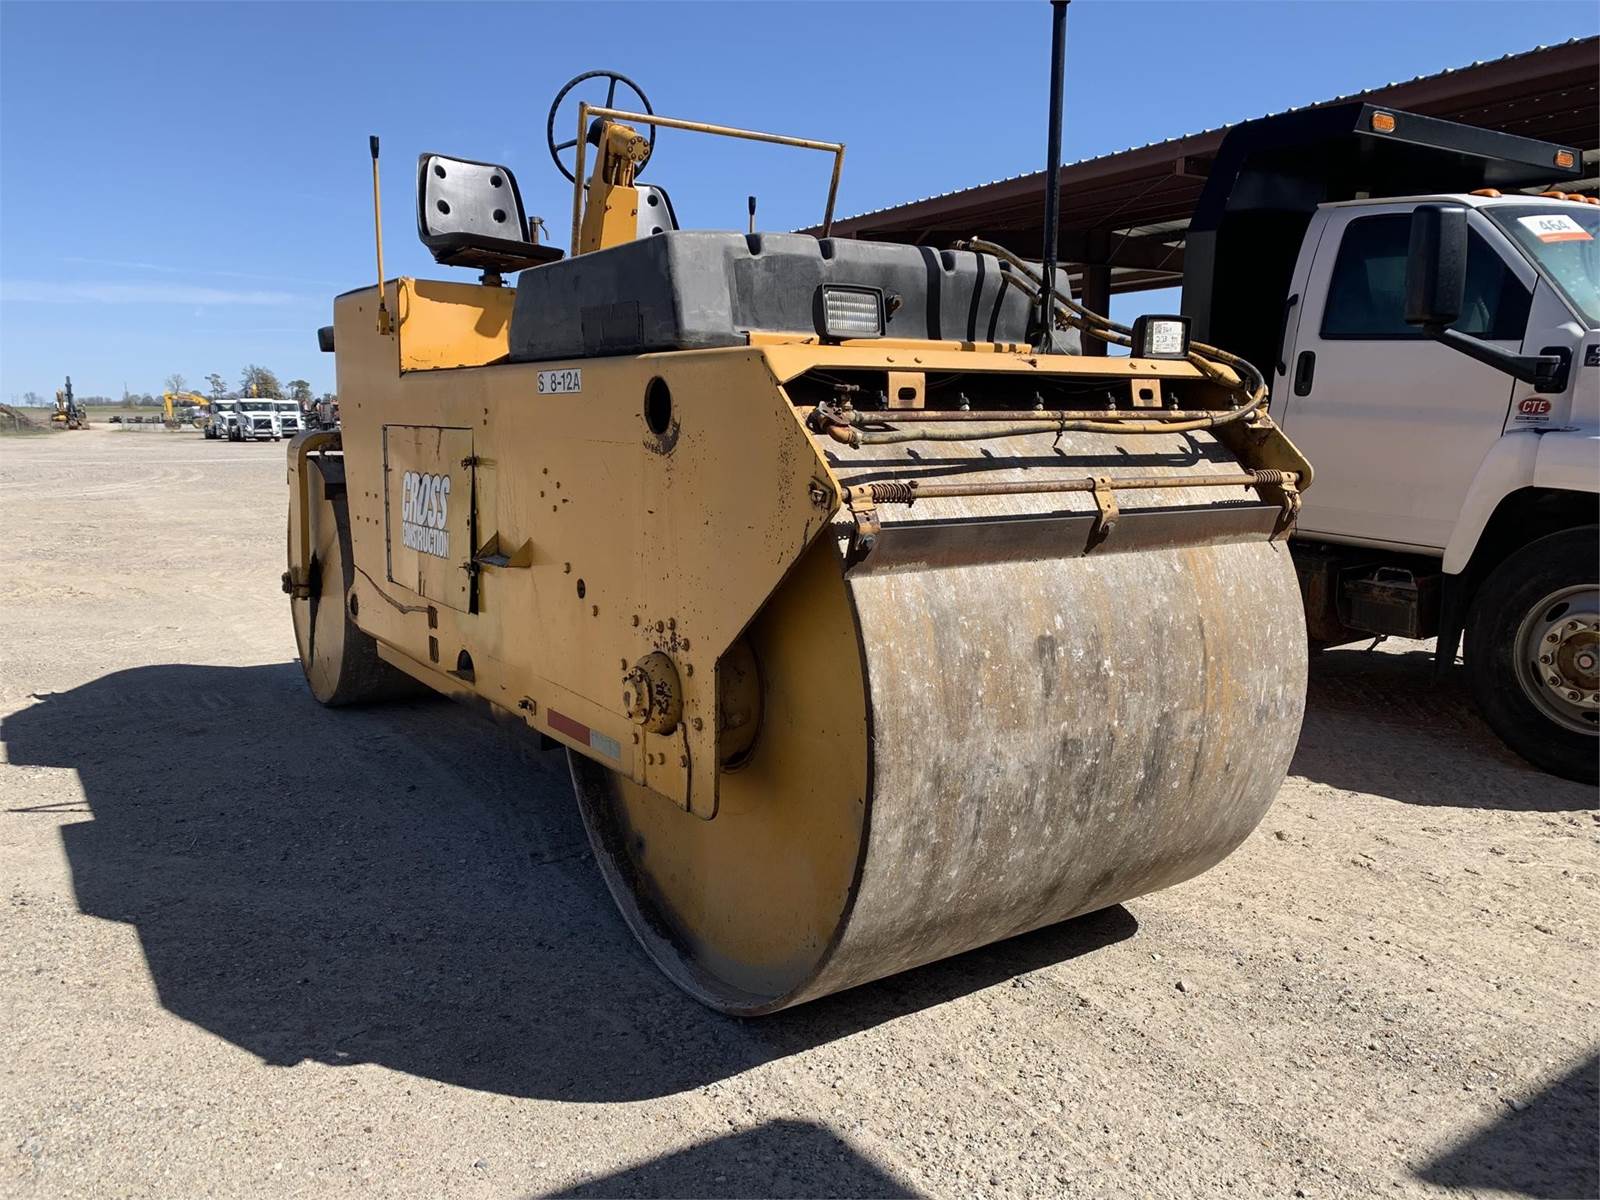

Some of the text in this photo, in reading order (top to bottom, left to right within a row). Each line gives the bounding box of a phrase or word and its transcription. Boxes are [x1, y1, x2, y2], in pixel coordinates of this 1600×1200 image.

[538, 371, 580, 392] S 8-12A
[1522, 400, 1546, 413] CTE
[402, 470, 451, 530] CROSS
[402, 520, 450, 559] CONSTRUCTION
